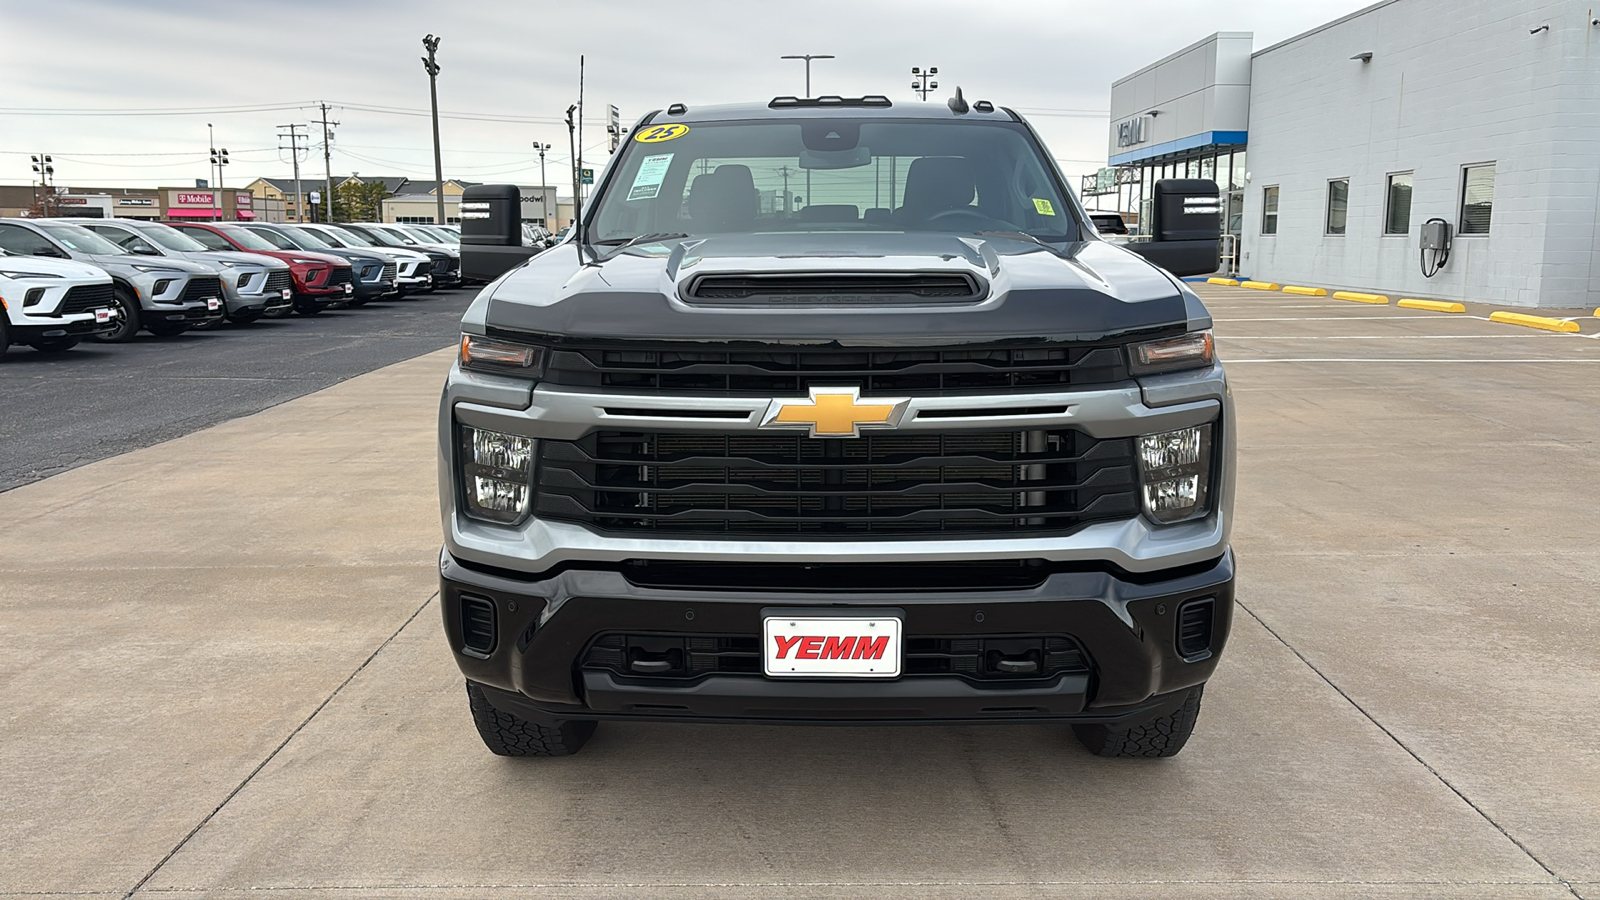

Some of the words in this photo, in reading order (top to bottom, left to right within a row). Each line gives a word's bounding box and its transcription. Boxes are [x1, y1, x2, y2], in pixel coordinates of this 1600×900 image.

[644, 126, 680, 140] 25
[187, 195, 212, 203] Mobile
[520, 195, 546, 203] oodwi
[774, 635, 890, 660] YEMM
